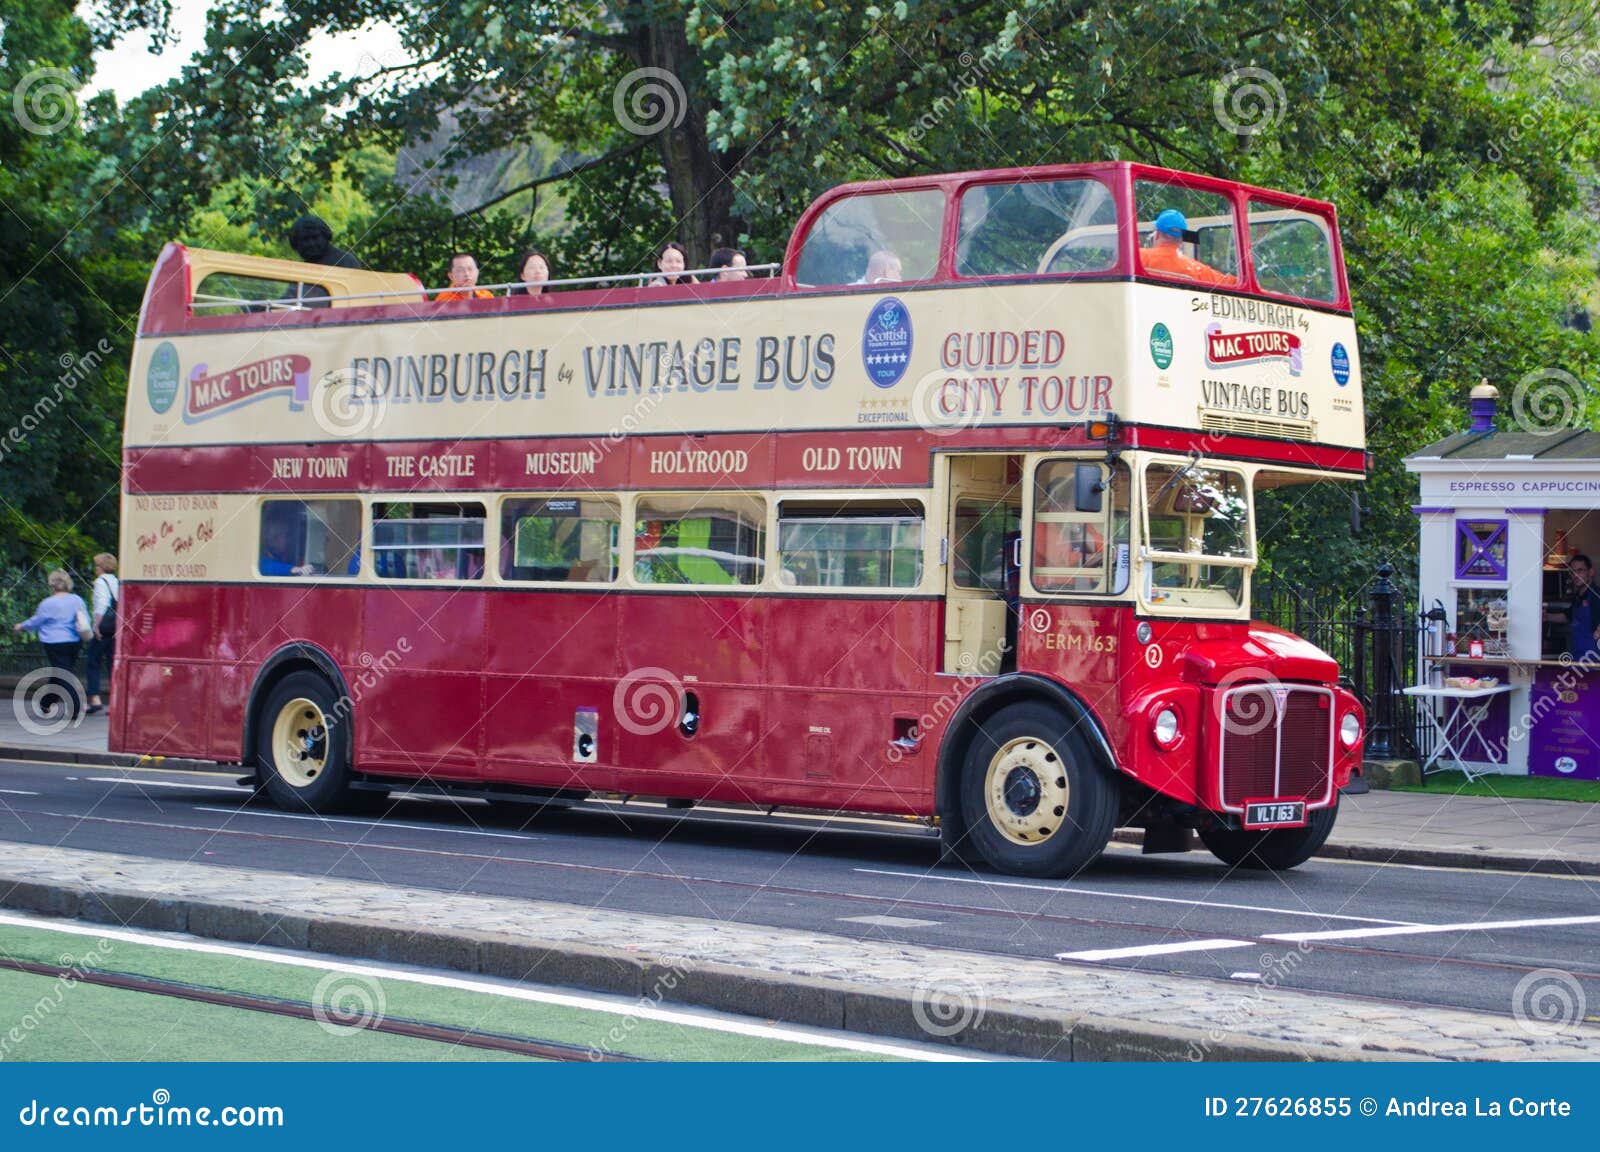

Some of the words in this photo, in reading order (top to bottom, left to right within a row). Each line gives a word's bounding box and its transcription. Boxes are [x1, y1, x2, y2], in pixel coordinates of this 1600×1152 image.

[1191, 297, 1209, 312] See
[1211, 294, 1296, 330] EDINBURGH
[1297, 313, 1310, 333] by
[868, 327, 907, 342] Scottish
[1212, 336, 1244, 358] MAC
[1246, 333, 1290, 353] TOURS
[942, 330, 1065, 369] GUIDED
[349, 349, 548, 402] EDINBURGH
[557, 361, 575, 384] by
[583, 337, 741, 395] VINTAGE
[755, 333, 836, 389] BUS
[877, 369, 896, 378] TOUR
[195, 376, 232, 408] MAC
[236, 358, 293, 390] TOURS
[940, 377, 1009, 415] CITY
[1020, 375, 1113, 415] TOUR
[1201, 379, 1272, 412] VINTAGE
[1277, 389, 1310, 418] BUS
[858, 411, 909, 423] EXCEPTIONAL
[272, 457, 304, 478] NEW
[307, 457, 348, 478] TOWN
[386, 456, 414, 477] THE
[419, 454, 475, 477] CASTLE
[525, 452, 595, 475] MUSEUM
[650, 449, 748, 474] HOLYROOD
[803, 447, 841, 471] OLD
[847, 446, 902, 470] TOWN
[1450, 481, 1516, 492] ESPRESSO
[1522, 481, 1600, 492] CAPPUCCIN
[1046, 633, 1082, 650] ERM
[1087, 635, 1114, 652] 163
